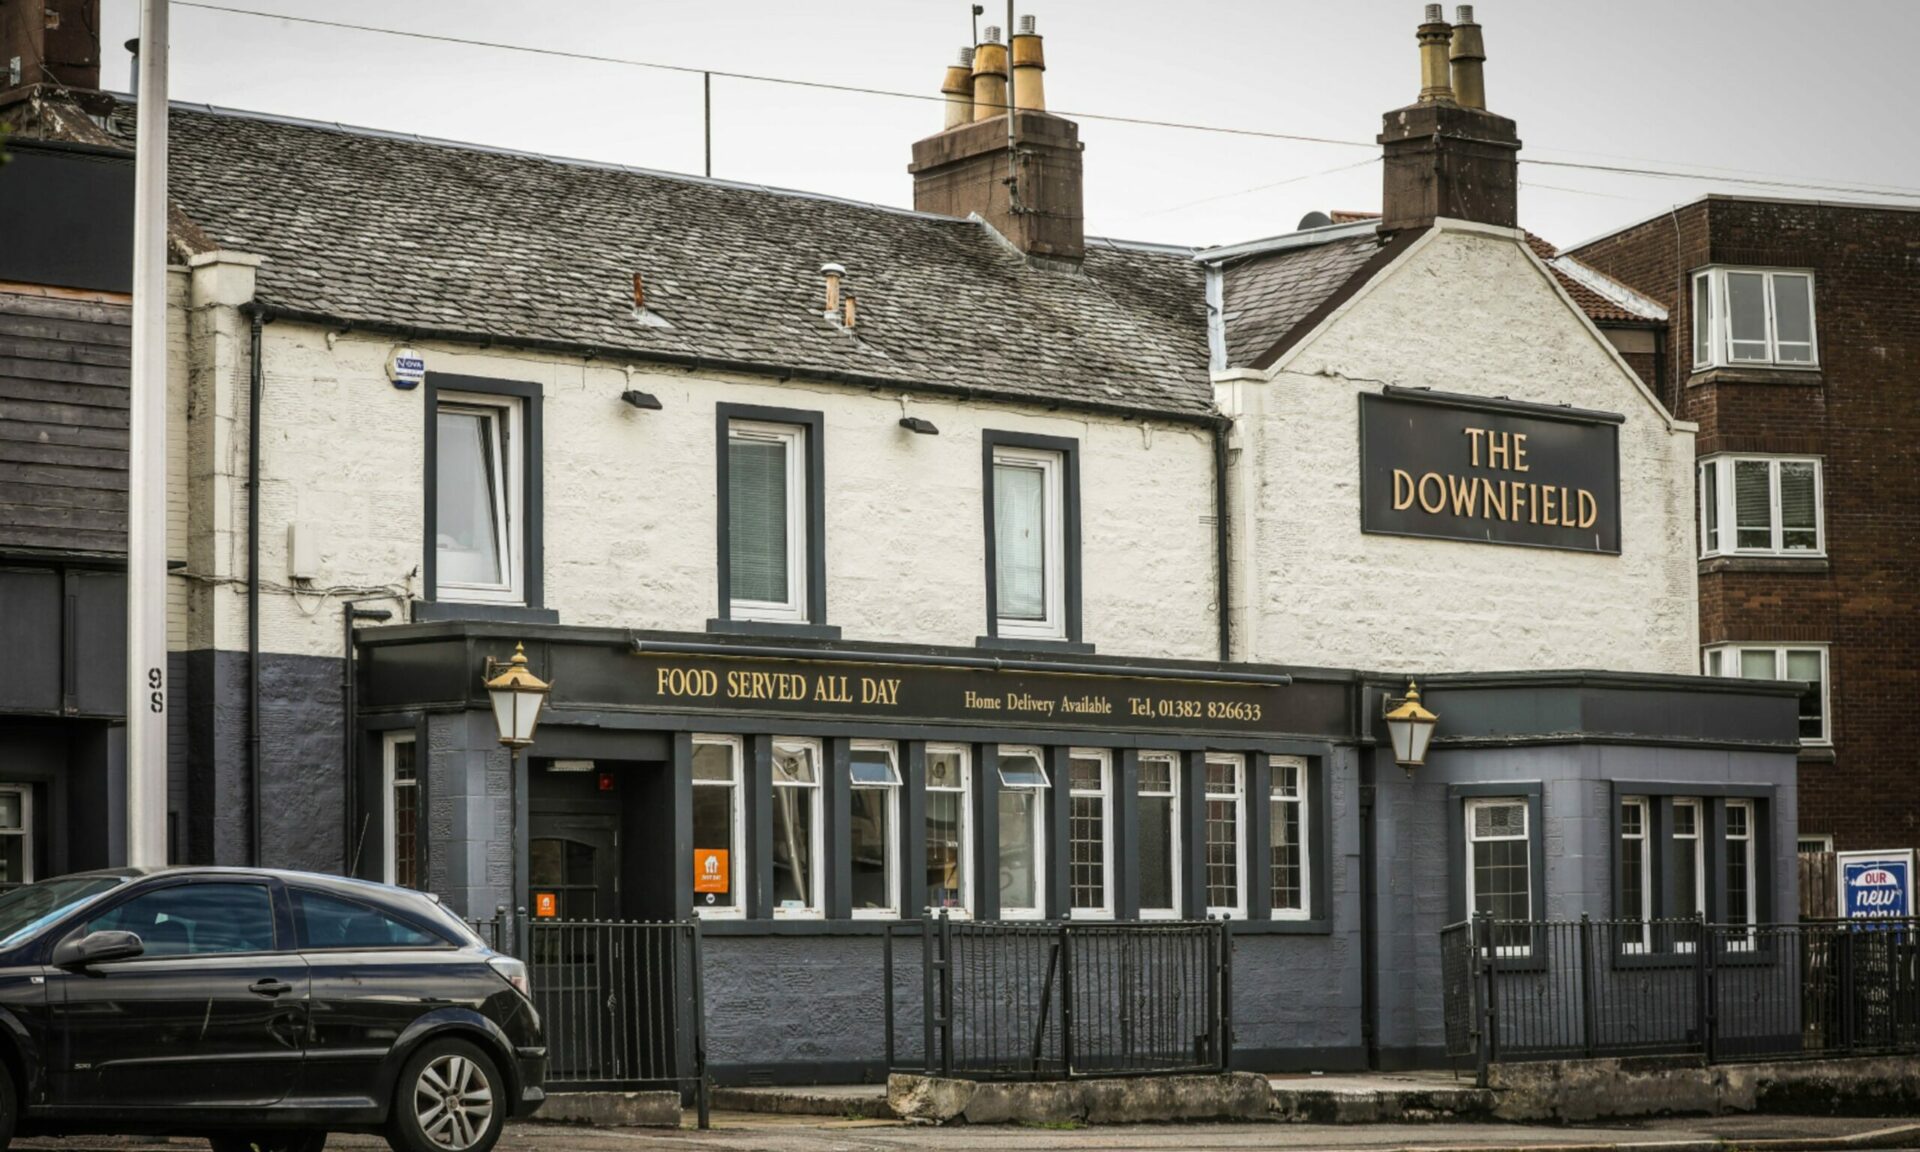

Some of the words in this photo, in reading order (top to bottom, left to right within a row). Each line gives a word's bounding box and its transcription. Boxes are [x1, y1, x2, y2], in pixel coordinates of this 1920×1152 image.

[396, 357, 423, 370] NOVA
[1464, 427, 1530, 472] THE
[1393, 469, 1598, 529] DOWNFIELD
[656, 668, 718, 697] FOOD
[727, 670, 807, 700] SERVED
[814, 675, 853, 702] ALL
[861, 678, 901, 705] DAY
[964, 691, 1001, 710] Home
[1007, 693, 1055, 717] Delivery
[1061, 696, 1112, 714] Available
[1128, 697, 1156, 719] Tel,
[1158, 699, 1202, 718] 01382
[1208, 701, 1262, 721] 826633
[1865, 872, 1887, 884] OUR
[1856, 889, 1896, 906] new
